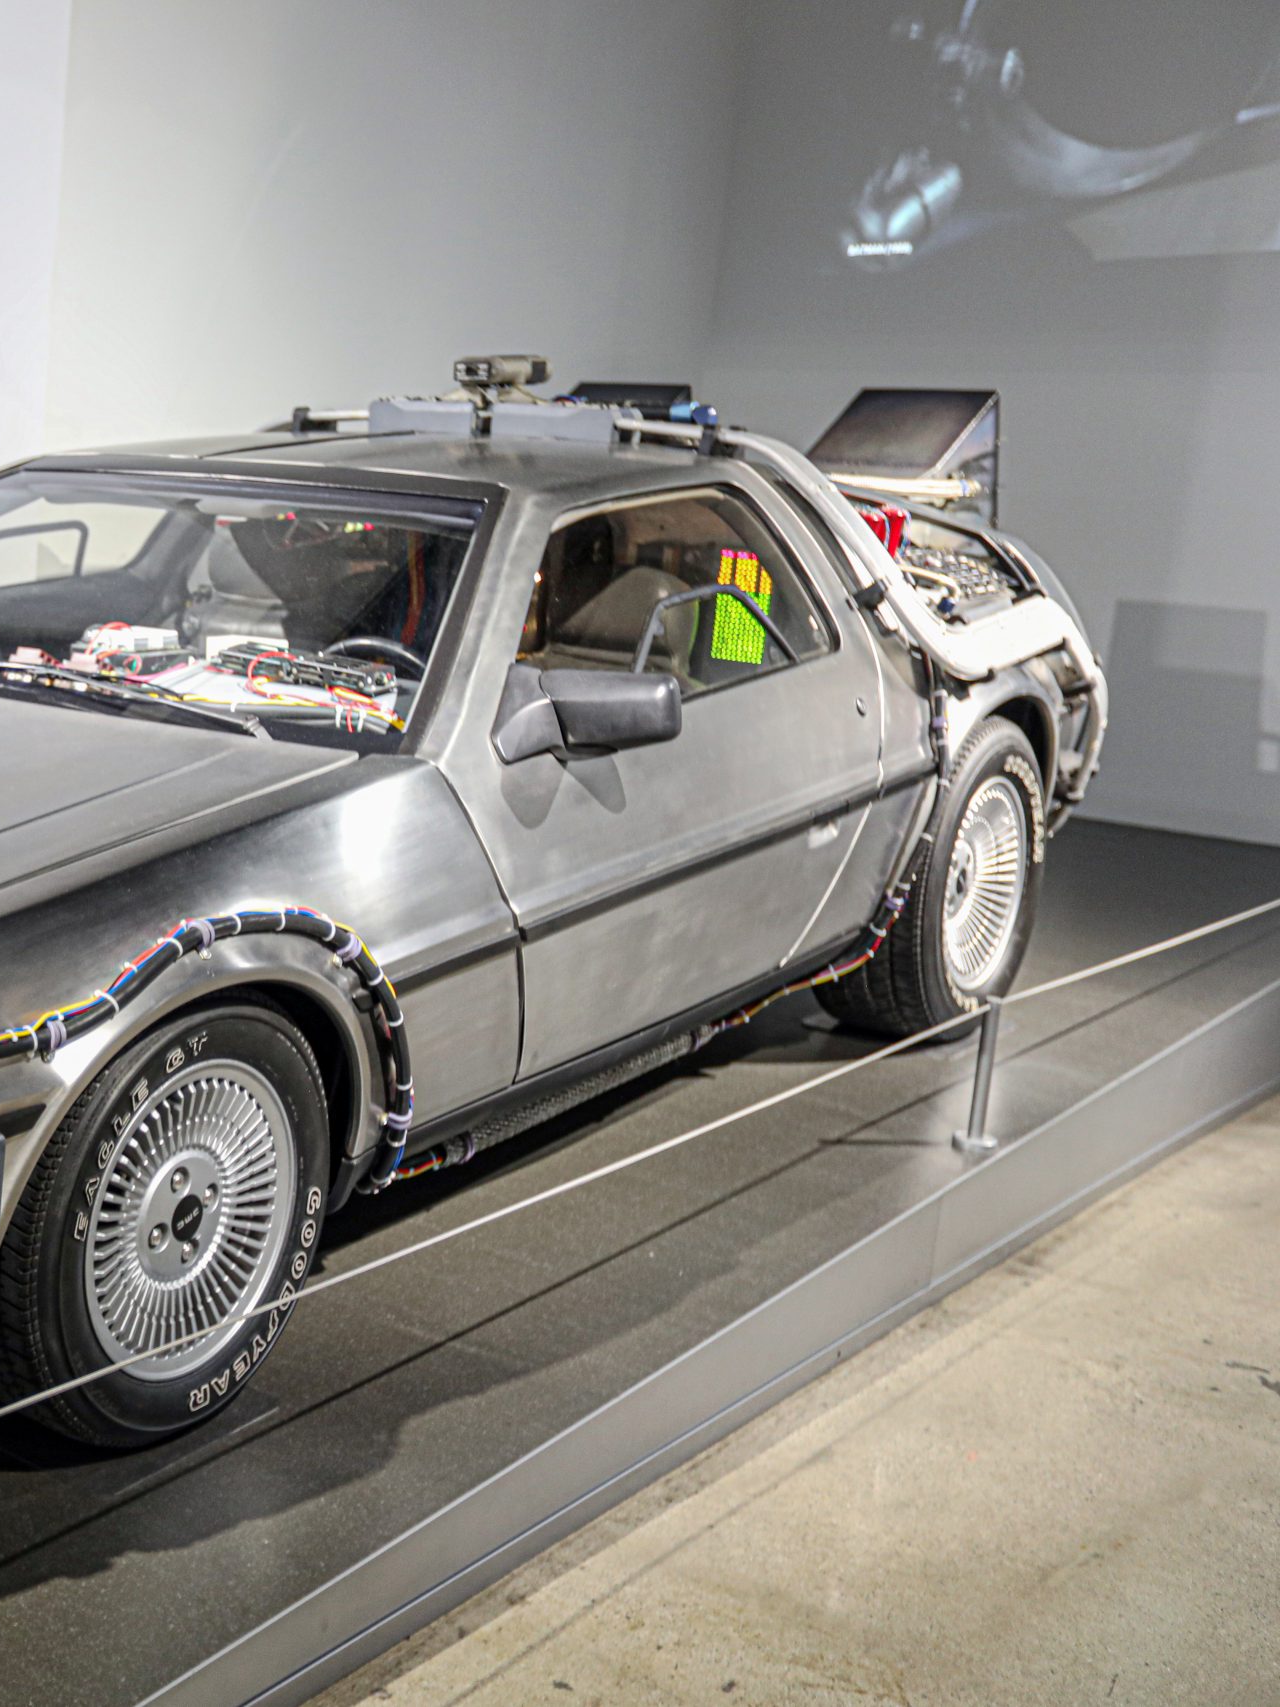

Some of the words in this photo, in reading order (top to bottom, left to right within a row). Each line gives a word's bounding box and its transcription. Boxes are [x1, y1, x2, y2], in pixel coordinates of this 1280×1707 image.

[73, 1079, 150, 1241] EAGLE
[166, 1031, 208, 1073] GT
[189, 1185, 322, 1412] GOODYEAR
